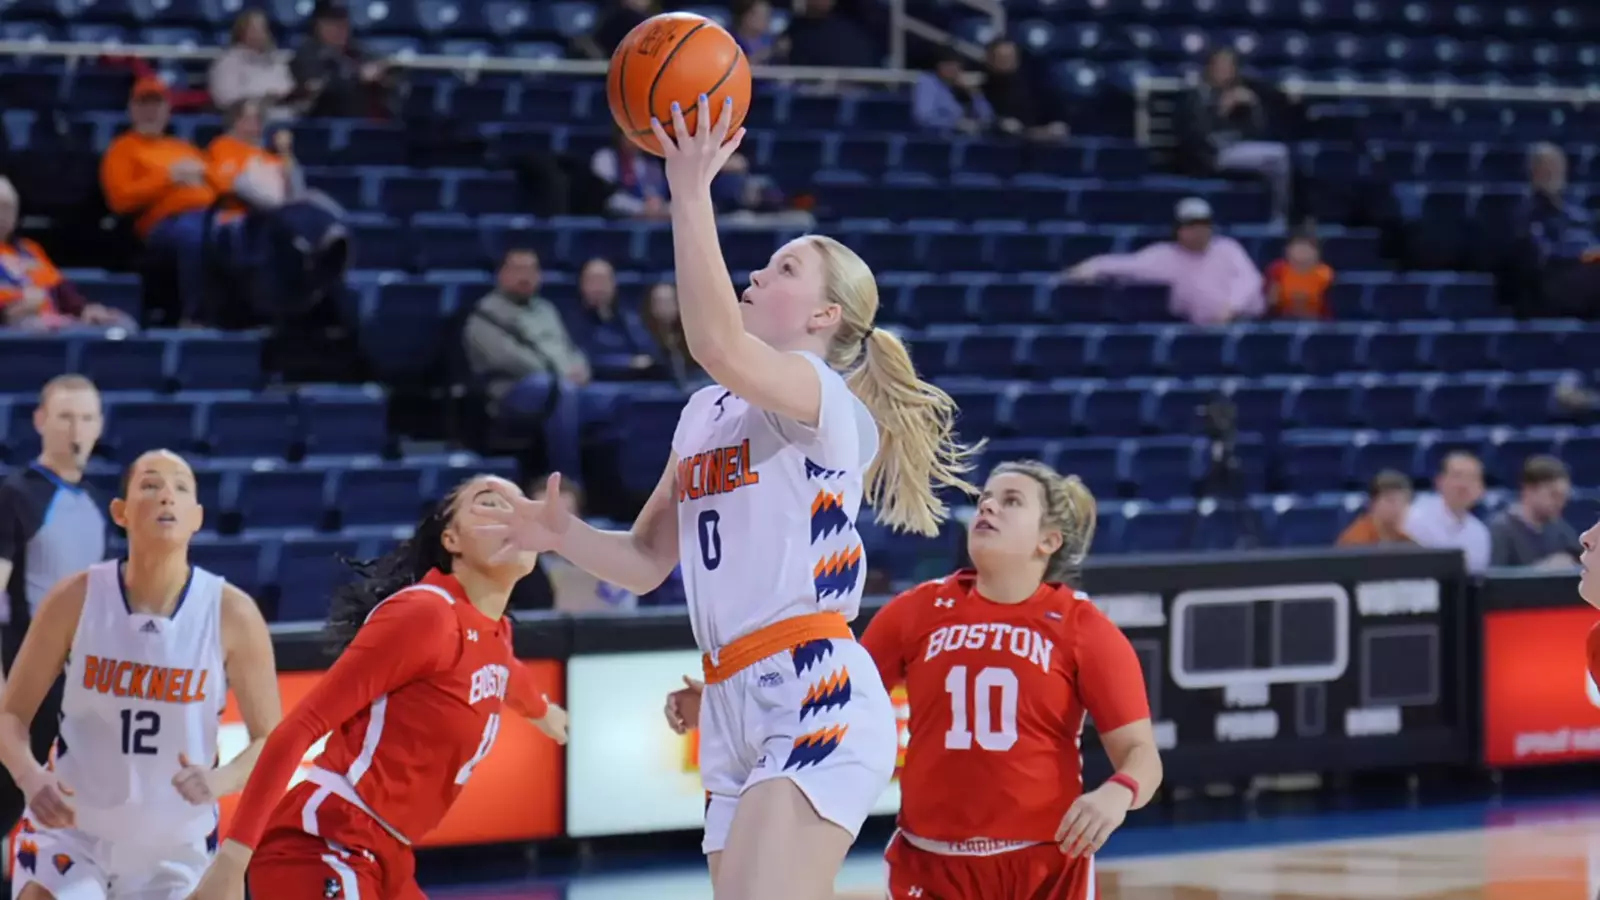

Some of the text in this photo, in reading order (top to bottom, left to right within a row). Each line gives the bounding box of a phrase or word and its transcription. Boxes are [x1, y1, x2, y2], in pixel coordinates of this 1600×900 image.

[698, 509, 721, 571] 0
[924, 622, 1054, 675] BOSTON
[83, 654, 208, 704] BUCKNELL
[120, 708, 161, 755] 12
[944, 665, 1019, 752] 10
